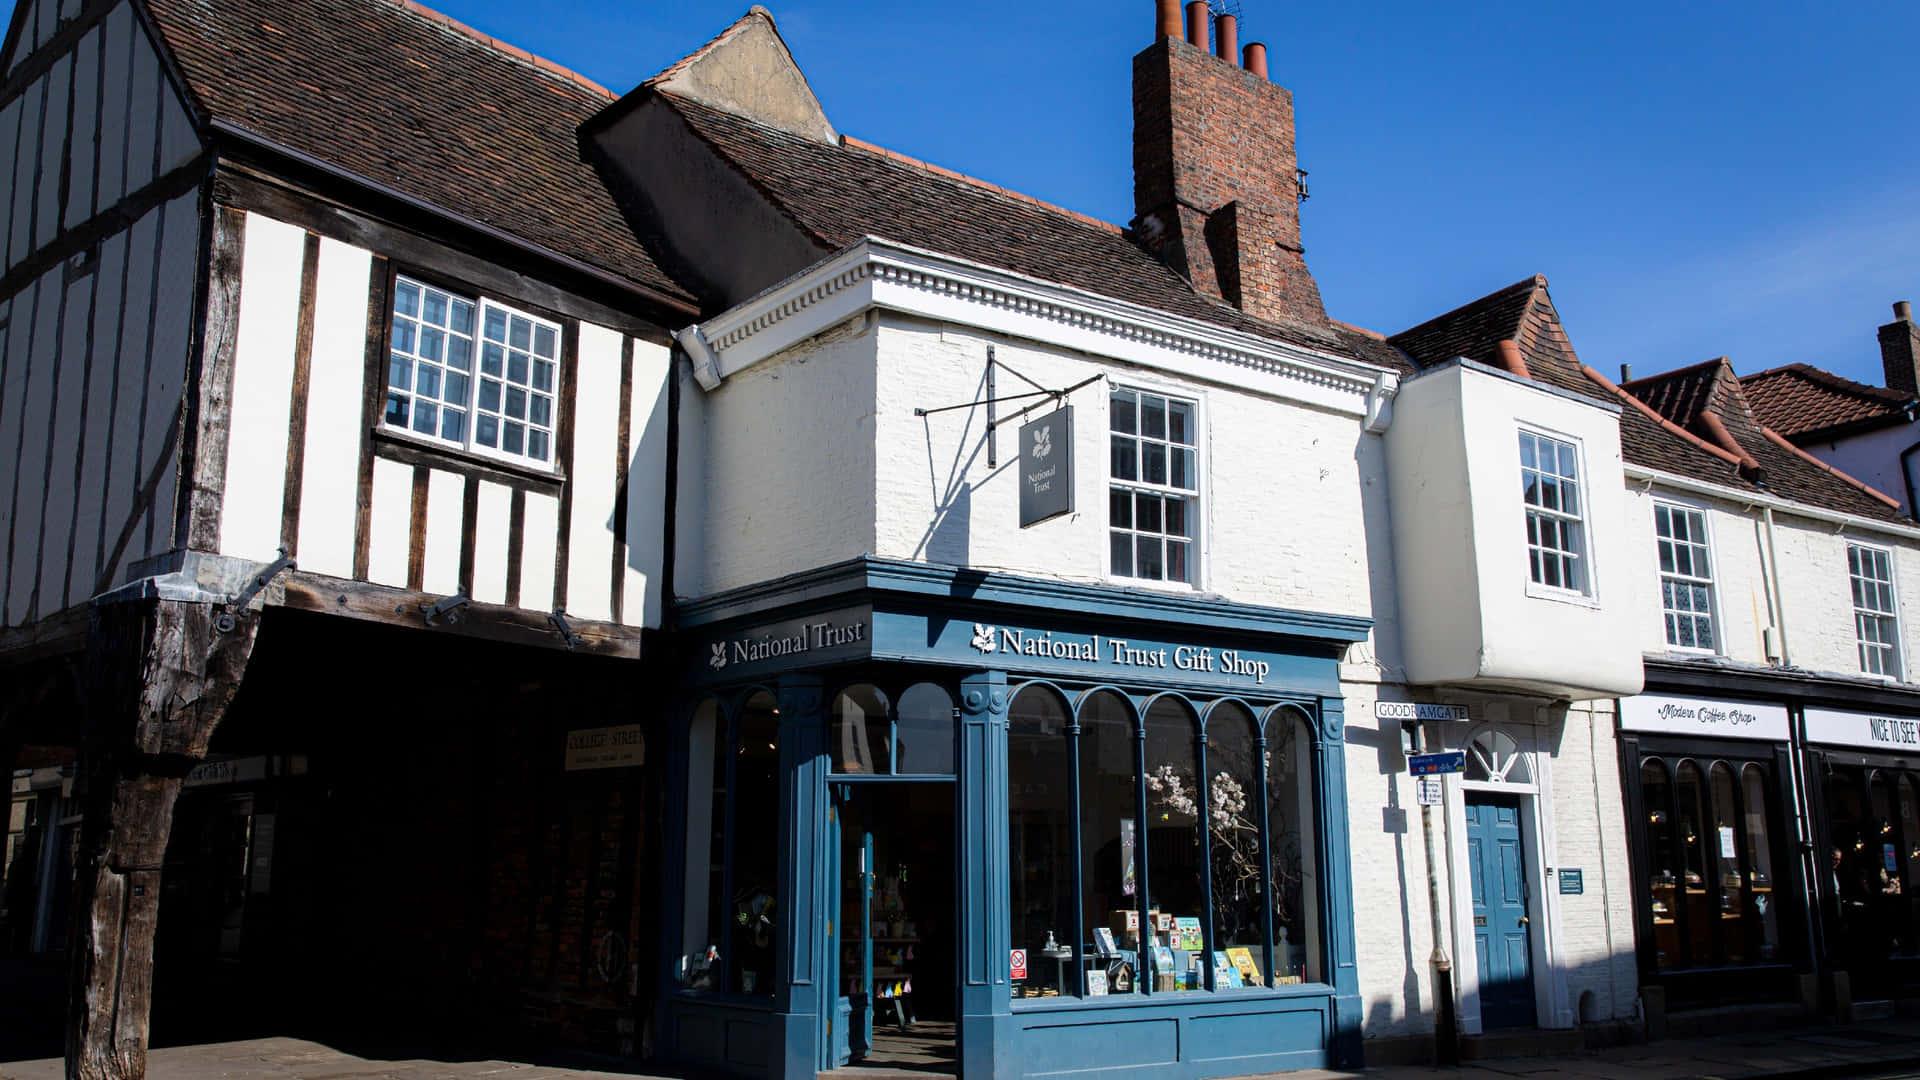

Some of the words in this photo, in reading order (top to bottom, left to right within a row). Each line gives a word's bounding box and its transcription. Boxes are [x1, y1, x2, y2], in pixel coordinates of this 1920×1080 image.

[1027, 464, 1056, 484] National
[1033, 480, 1050, 494] Trust
[733, 624, 808, 664] National
[812, 622, 863, 648] Trust
[1000, 628, 1099, 661] National
[1108, 639, 1167, 667] Trust
[1174, 646, 1213, 671] Gift
[1221, 650, 1269, 683] Shop
[1379, 703, 1465, 718] GOODRAMGATE
[1661, 704, 1695, 720] Modern
[1698, 707, 1726, 723] Coffee
[1729, 709, 1752, 725] Shop
[610, 729, 643, 745] STREET
[1870, 718, 1889, 741] NICE
[1889, 720, 1900, 743] TO
[1900, 721, 1917, 744] SEE
